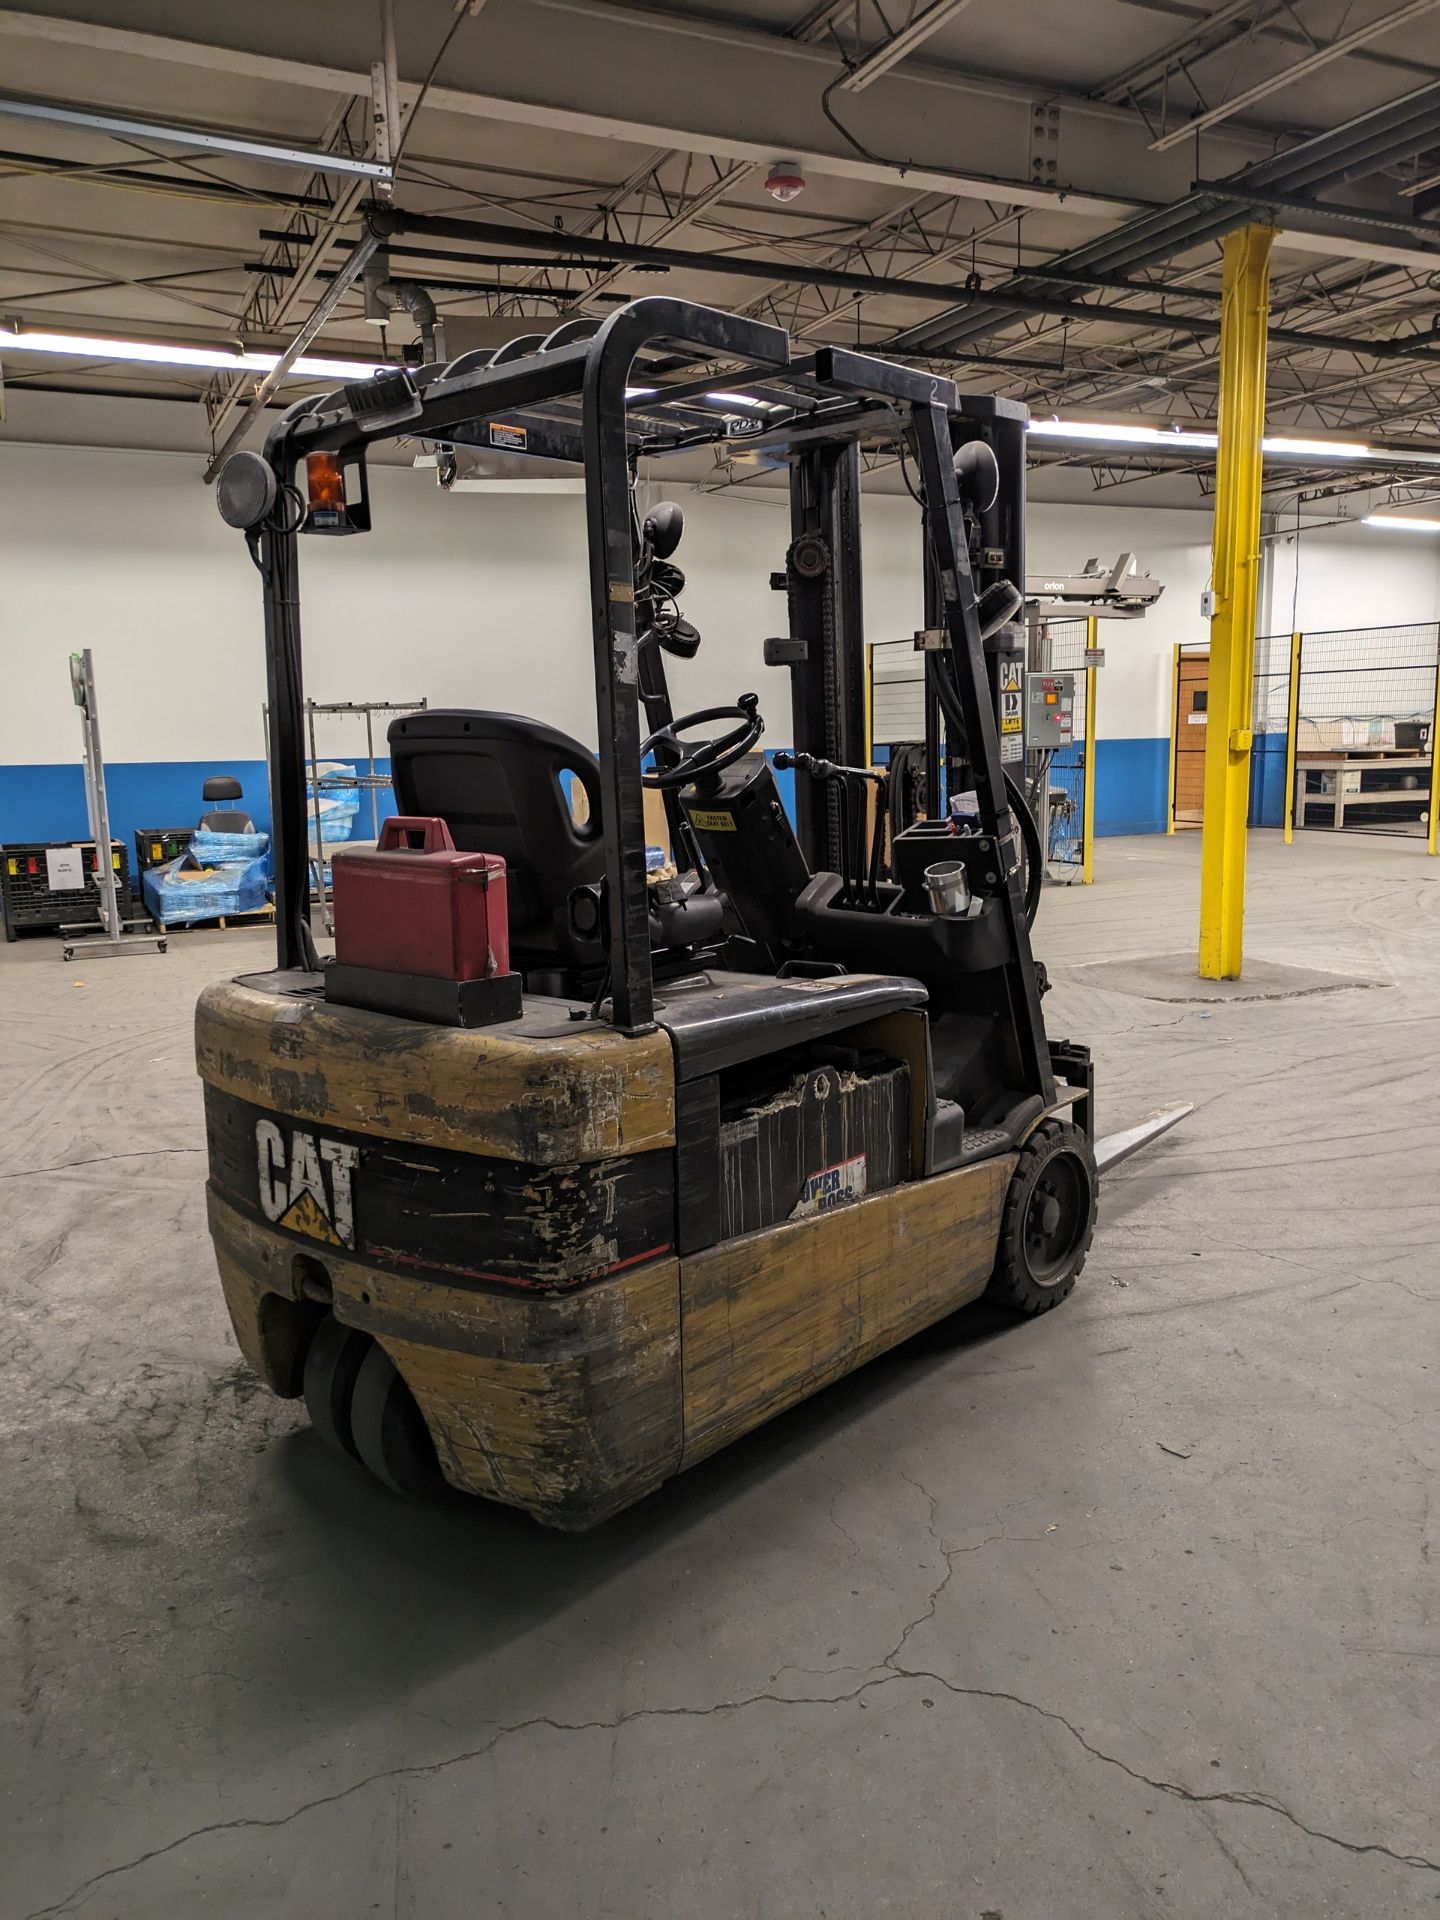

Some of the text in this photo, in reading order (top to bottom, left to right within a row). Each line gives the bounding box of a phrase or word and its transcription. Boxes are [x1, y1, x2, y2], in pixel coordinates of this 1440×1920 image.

[930, 379, 938, 401] 2
[1044, 581, 1065, 591] orion
[1000, 662, 1024, 690] CAT
[255, 1119, 359, 1250] CAT
